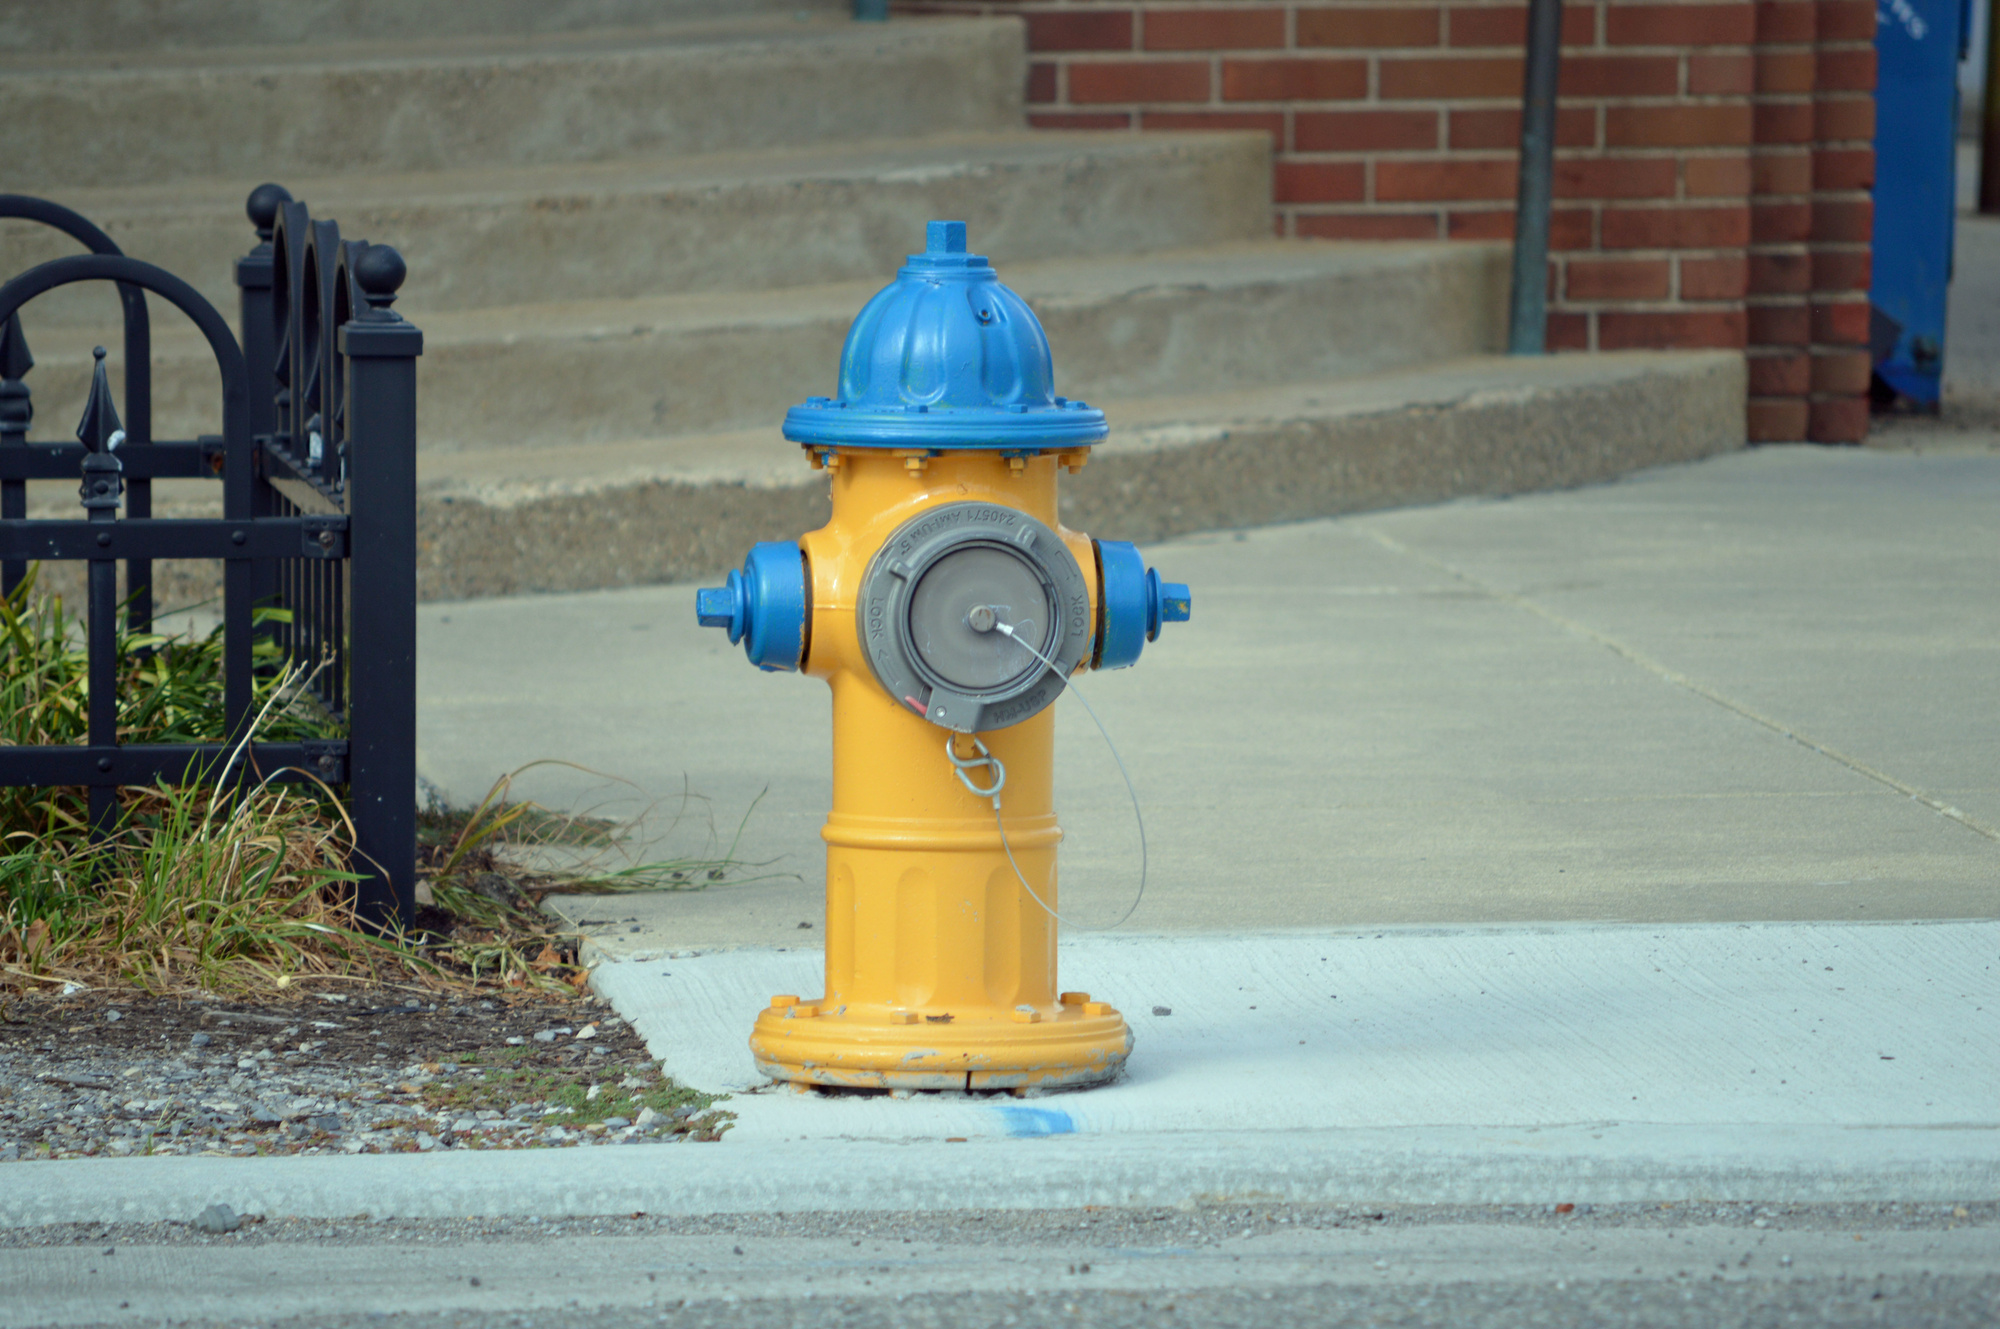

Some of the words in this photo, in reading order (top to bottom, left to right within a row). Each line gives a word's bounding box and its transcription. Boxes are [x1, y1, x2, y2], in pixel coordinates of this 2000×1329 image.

[966, 508, 1016, 527] 240571
[870, 597, 884, 641] LOCK
[1071, 594, 1085, 638] LOCK
